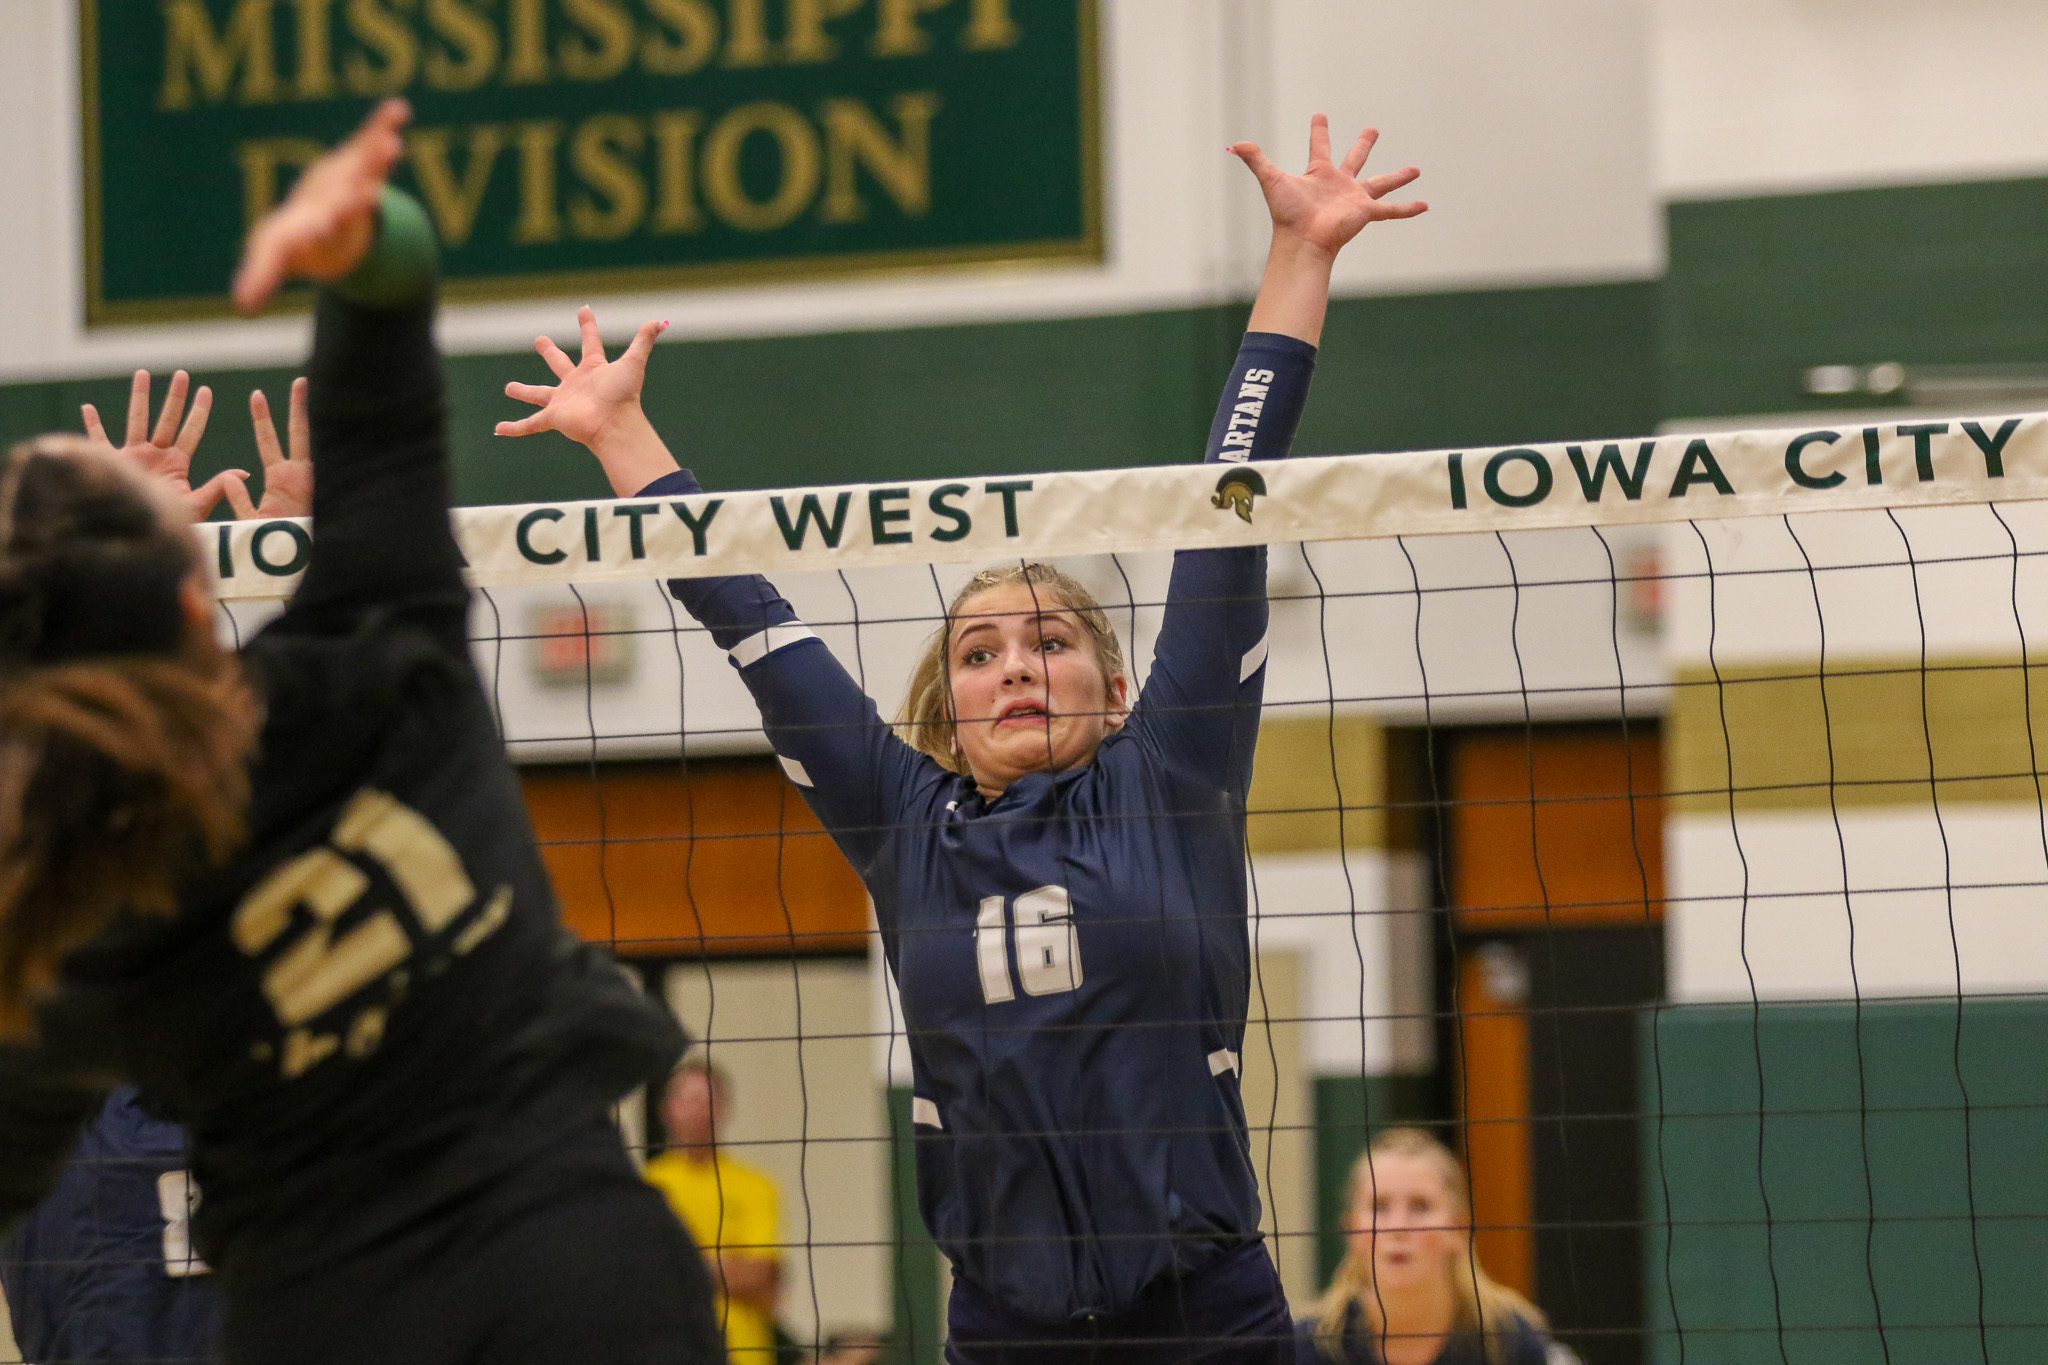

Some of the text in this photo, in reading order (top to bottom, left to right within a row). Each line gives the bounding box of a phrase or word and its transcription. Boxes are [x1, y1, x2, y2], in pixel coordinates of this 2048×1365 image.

[236, 90, 944, 250] VISION
[1218, 367, 1276, 464] ARTANS
[516, 500, 723, 565] CITY
[771, 480, 1035, 551] WEST
[1447, 438, 1736, 511] IOWA
[1785, 418, 2022, 490] CITY
[973, 884, 1084, 1005] 16
